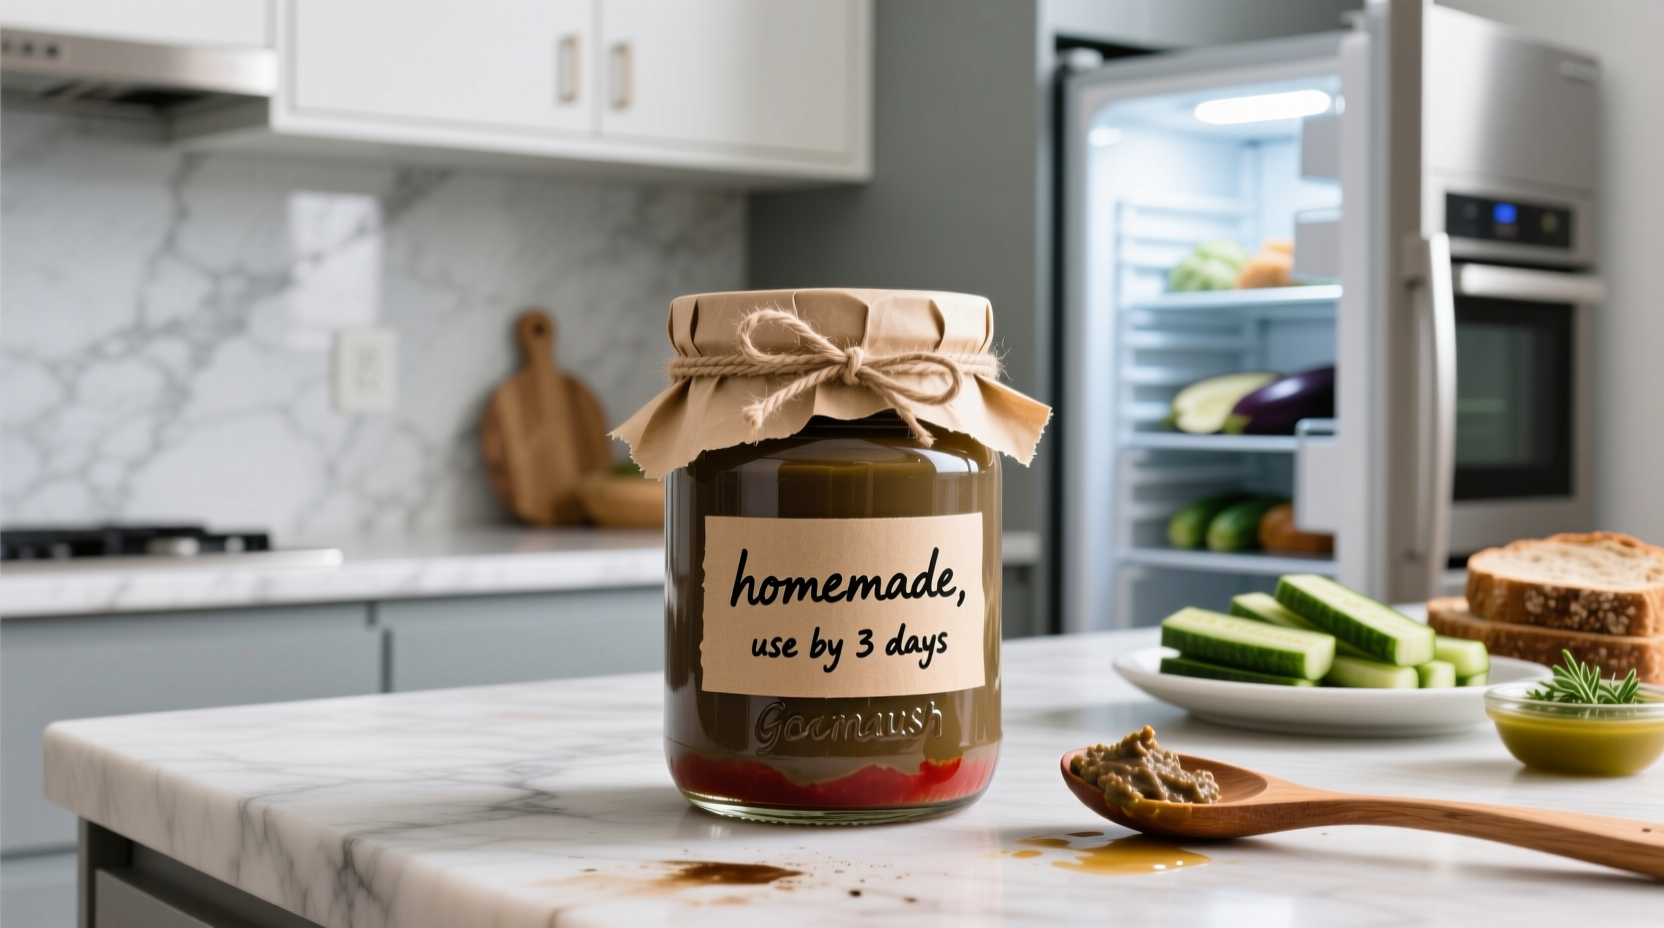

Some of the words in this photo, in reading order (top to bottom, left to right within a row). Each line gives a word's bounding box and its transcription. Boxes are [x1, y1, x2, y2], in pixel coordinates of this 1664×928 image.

[730, 548, 965, 607] homemade,
[752, 637, 798, 659] use
[810, 626, 843, 673] by
[856, 629, 875, 659] 3
[886, 623, 948, 670] days
